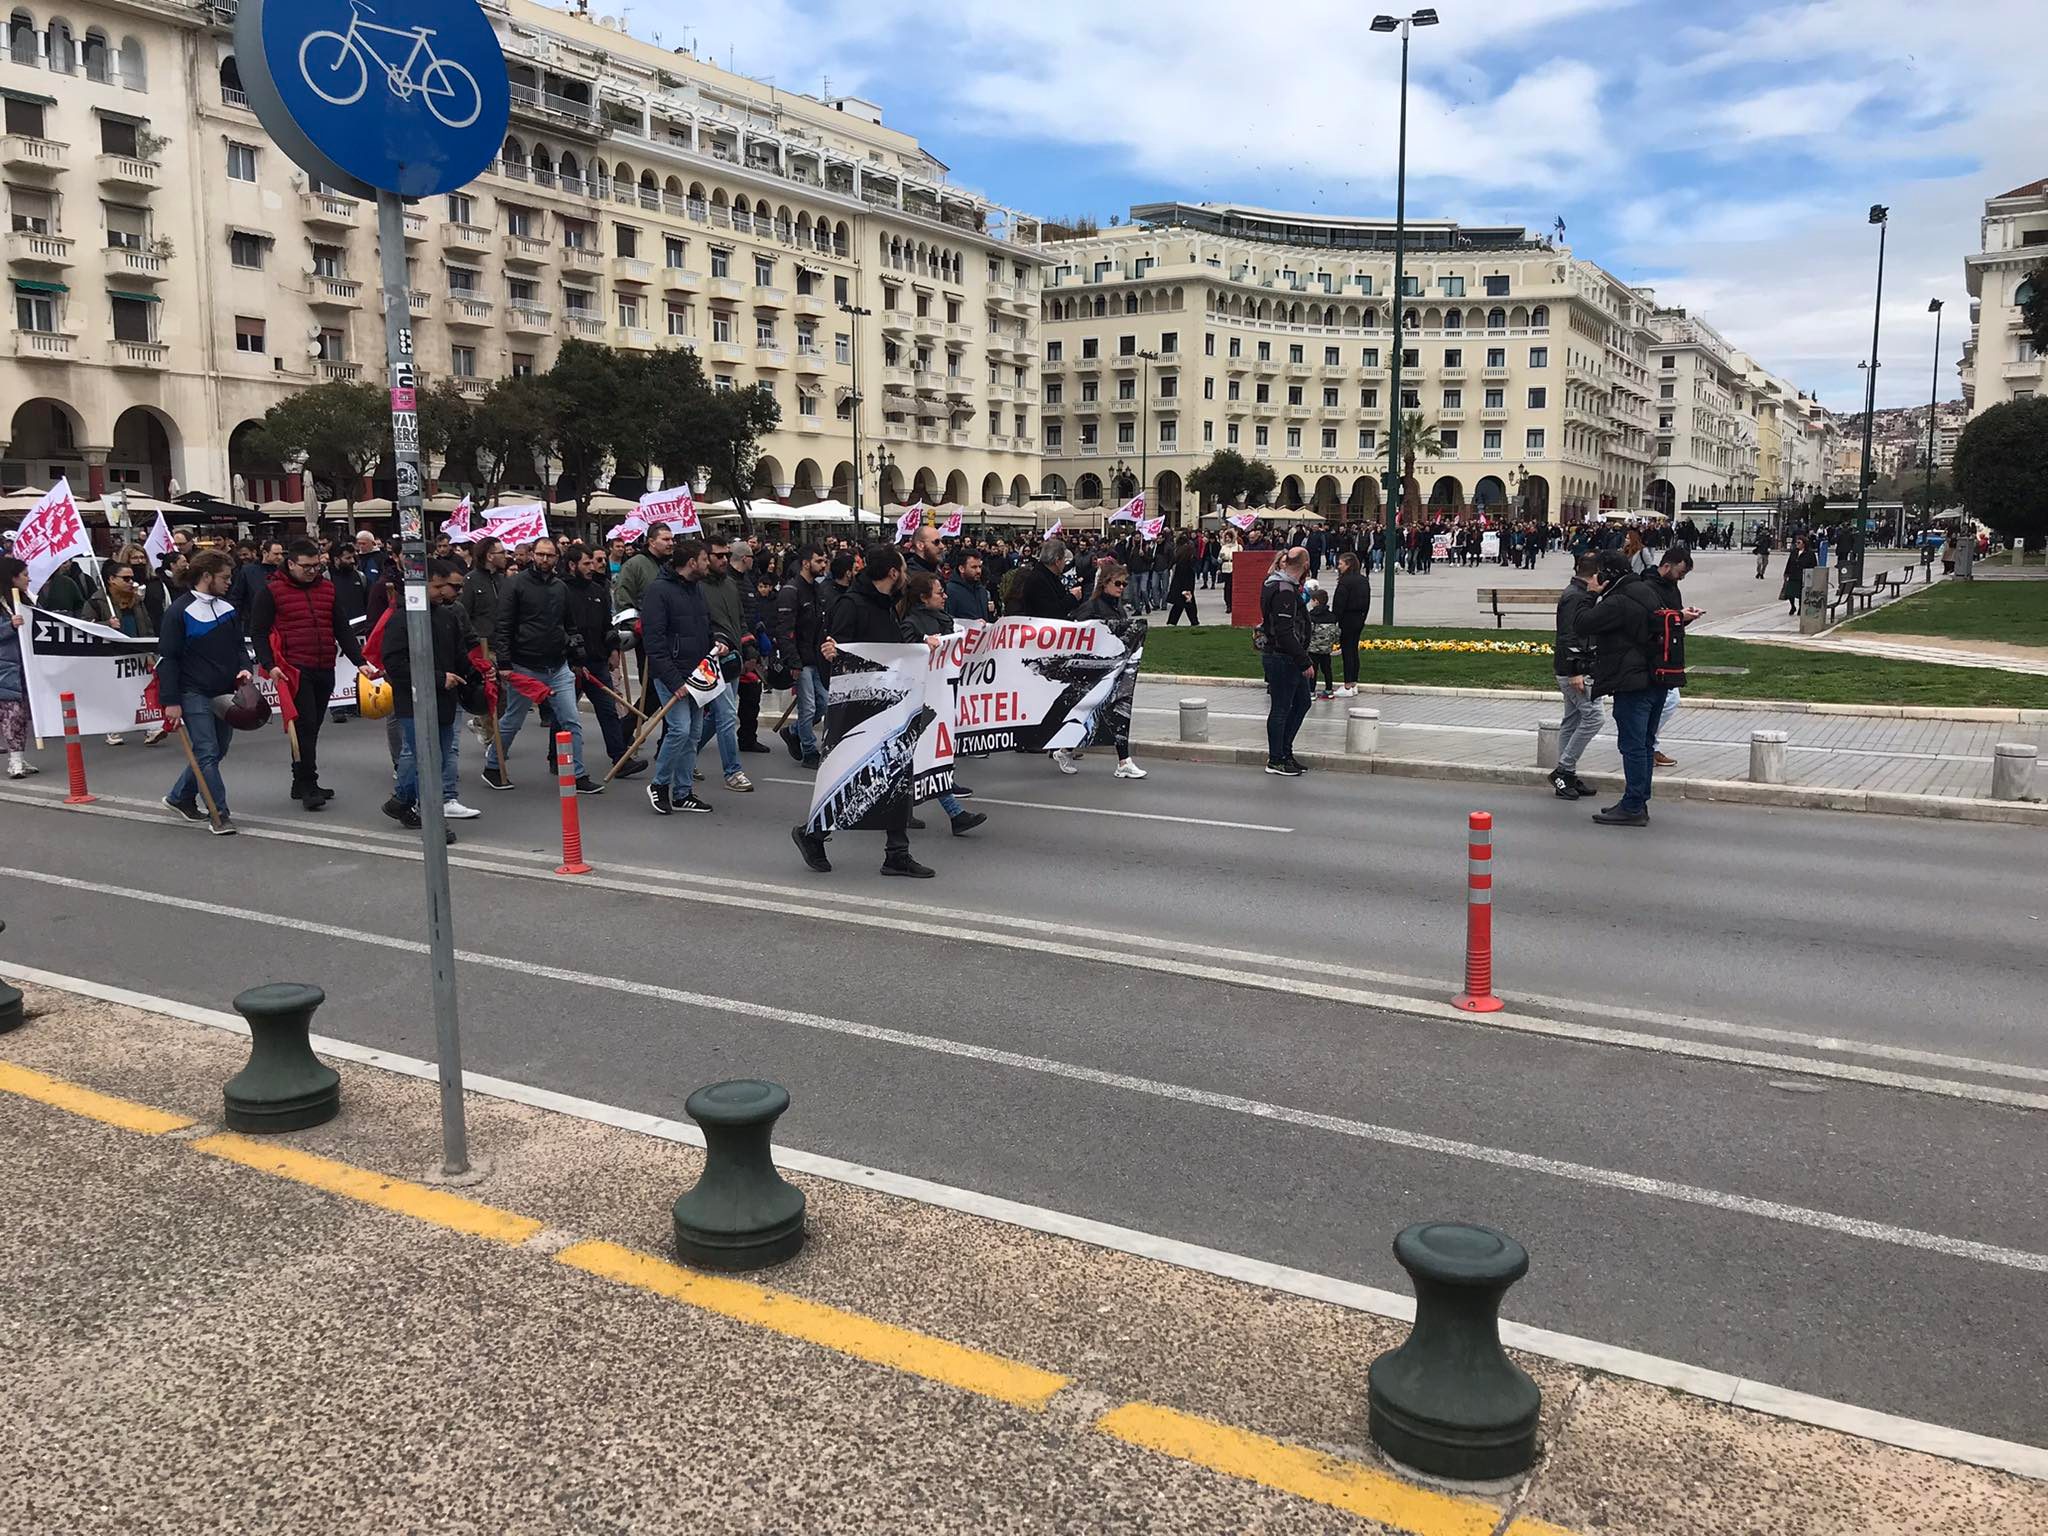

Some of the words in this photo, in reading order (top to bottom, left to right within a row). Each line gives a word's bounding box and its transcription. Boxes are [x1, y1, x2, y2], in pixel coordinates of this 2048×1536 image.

[1303, 464, 1349, 474] ELECTRA
[1352, 465, 1387, 475] PALAC
[955, 691, 1027, 727] ΑΣΤΕΙ.
[962, 731, 1018, 754] ΣΥΛΛΟΓΟΙ.
